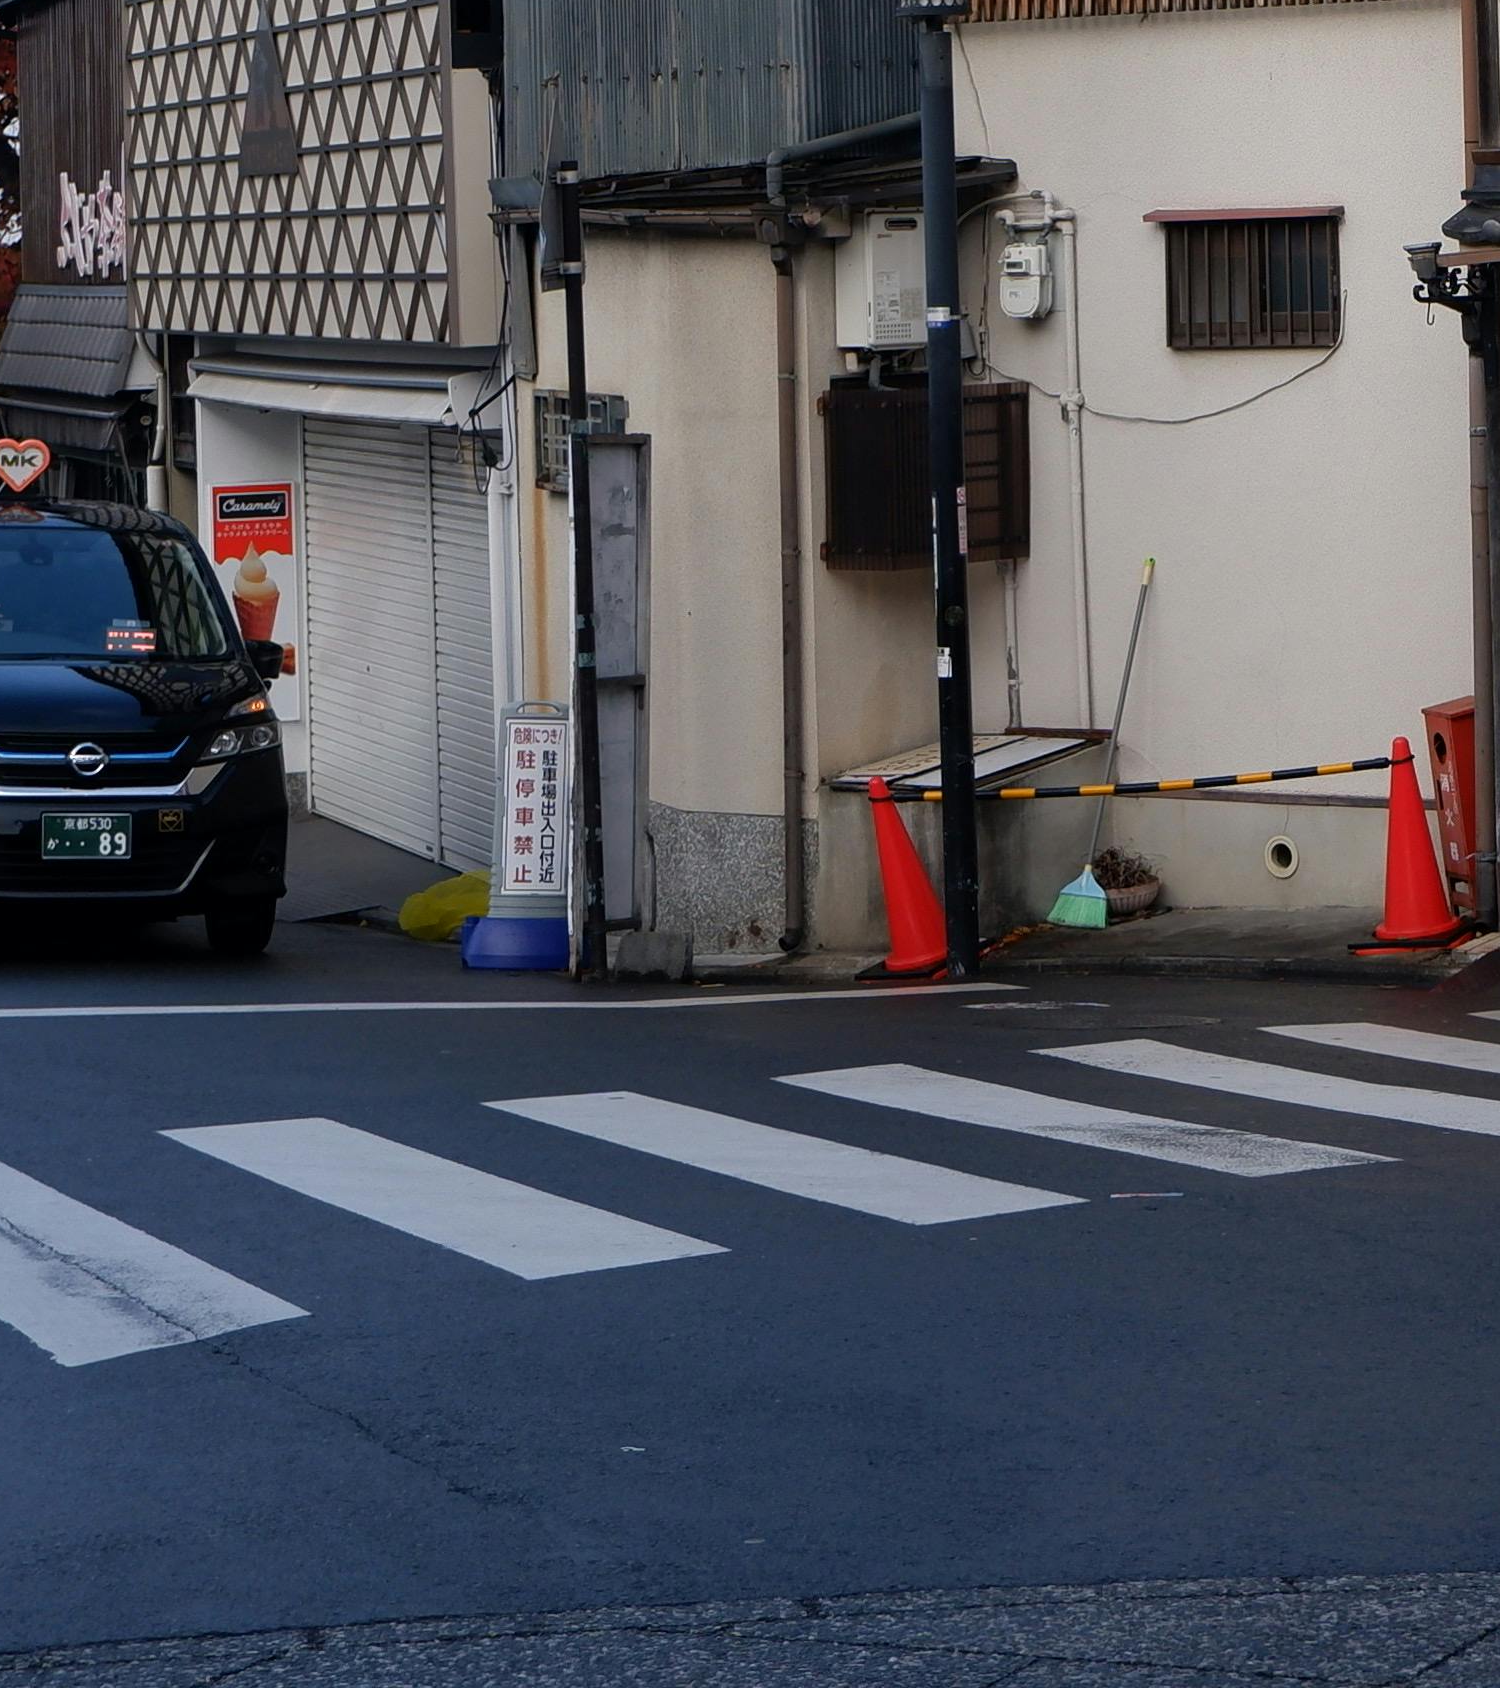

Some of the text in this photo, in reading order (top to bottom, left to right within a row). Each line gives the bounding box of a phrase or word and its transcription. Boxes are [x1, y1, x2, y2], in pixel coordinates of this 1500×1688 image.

[0, 454, 39, 467] MK
[222, 498, 282, 513] Caramely
[512, 749, 537, 884] 駐停車禁止
[538, 749, 559, 884] 駐車場出入口付近
